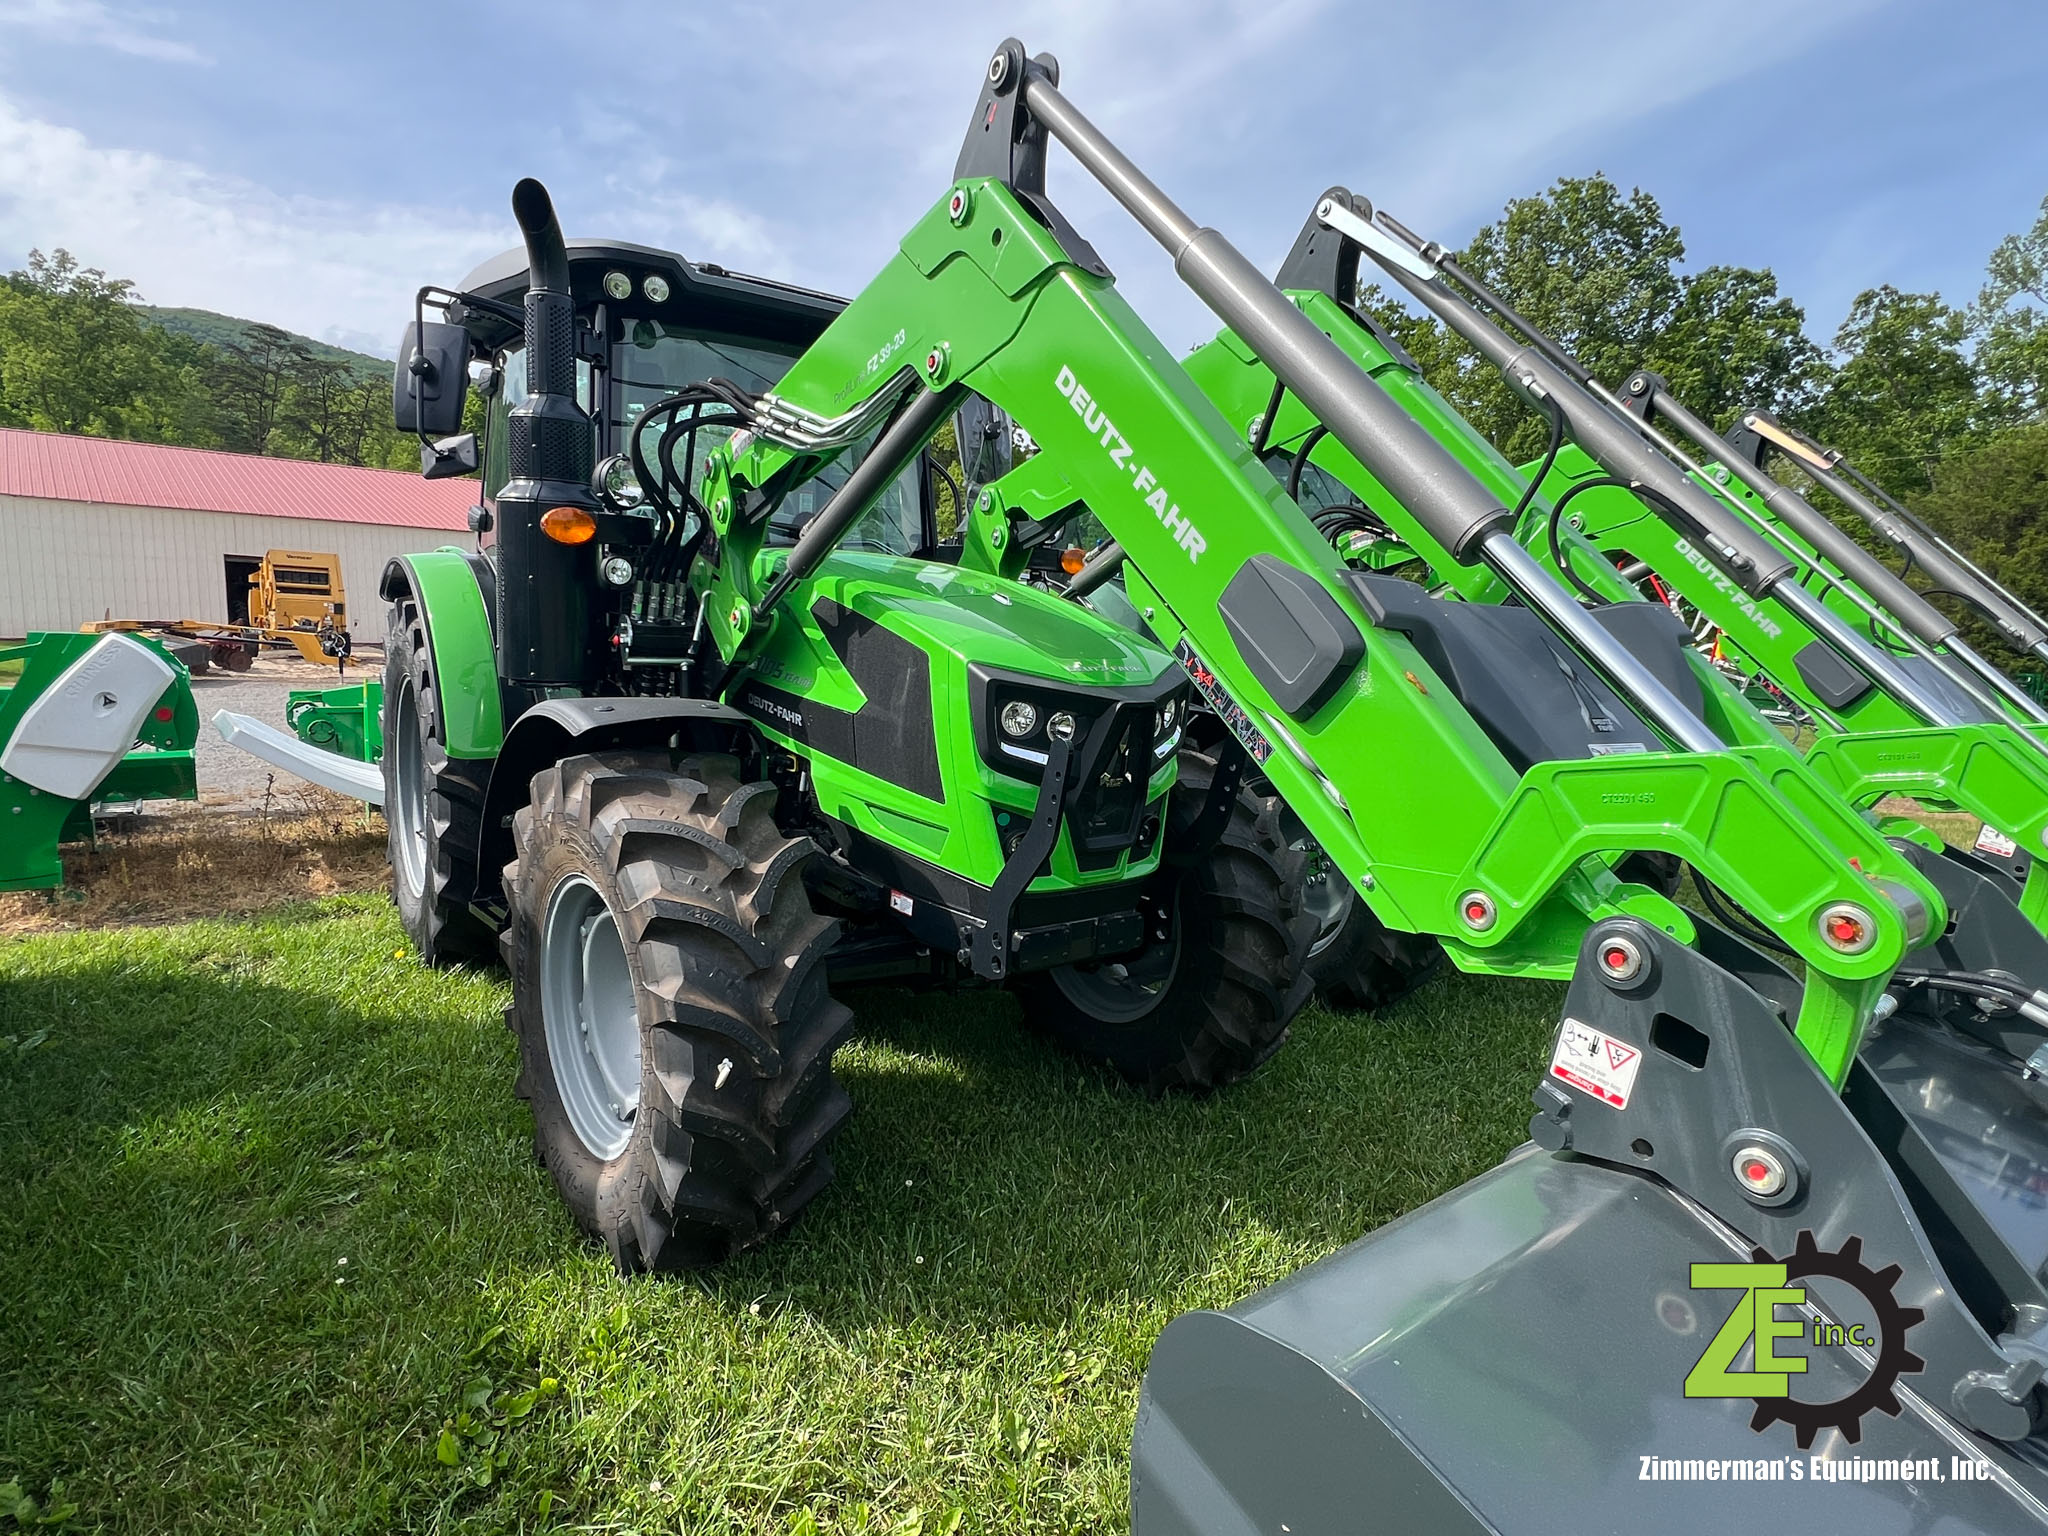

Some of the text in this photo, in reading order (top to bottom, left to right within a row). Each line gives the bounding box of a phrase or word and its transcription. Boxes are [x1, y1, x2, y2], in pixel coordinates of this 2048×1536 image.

[867, 353, 879, 375] FZ
[880, 328, 906, 363] 39-23
[1054, 364, 1207, 565] DEUTZ-FAHR
[1674, 539, 1782, 640] DEUTZ-FAHR
[748, 693, 803, 726] DEUTZ-FAHR
[1566, 1072, 1595, 1091] Danger
